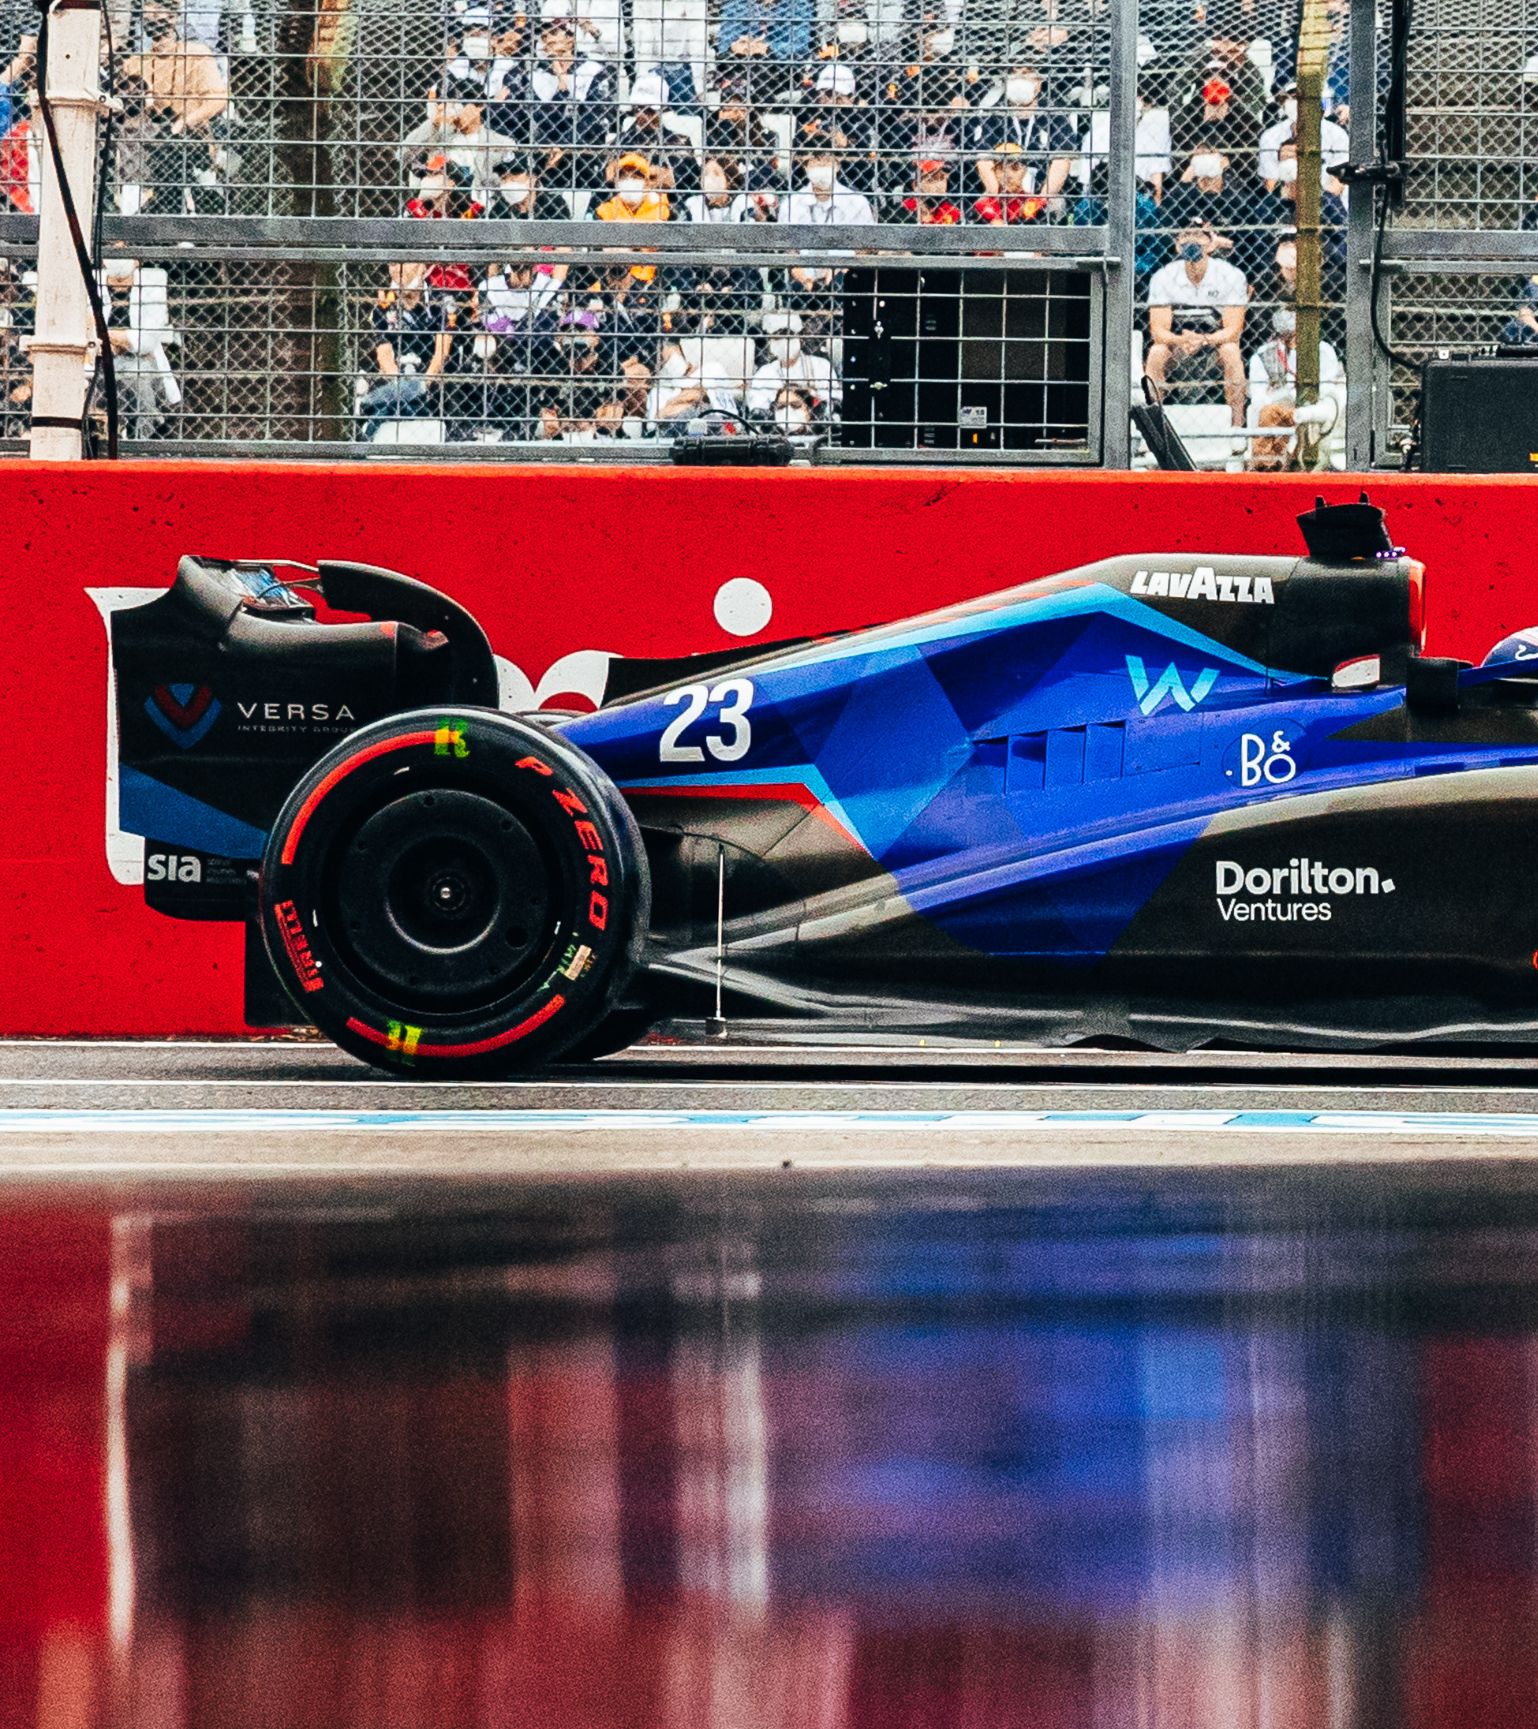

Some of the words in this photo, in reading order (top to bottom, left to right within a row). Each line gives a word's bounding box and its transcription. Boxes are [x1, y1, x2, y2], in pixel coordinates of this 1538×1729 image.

[1130, 566, 1275, 604] LAVAZZA
[237, 702, 355, 721] VERSA
[660, 678, 754, 762] 23
[552, 787, 609, 931] ZERO
[1216, 898, 1332, 921] Ventures
[274, 899, 325, 993] PIRELLI
